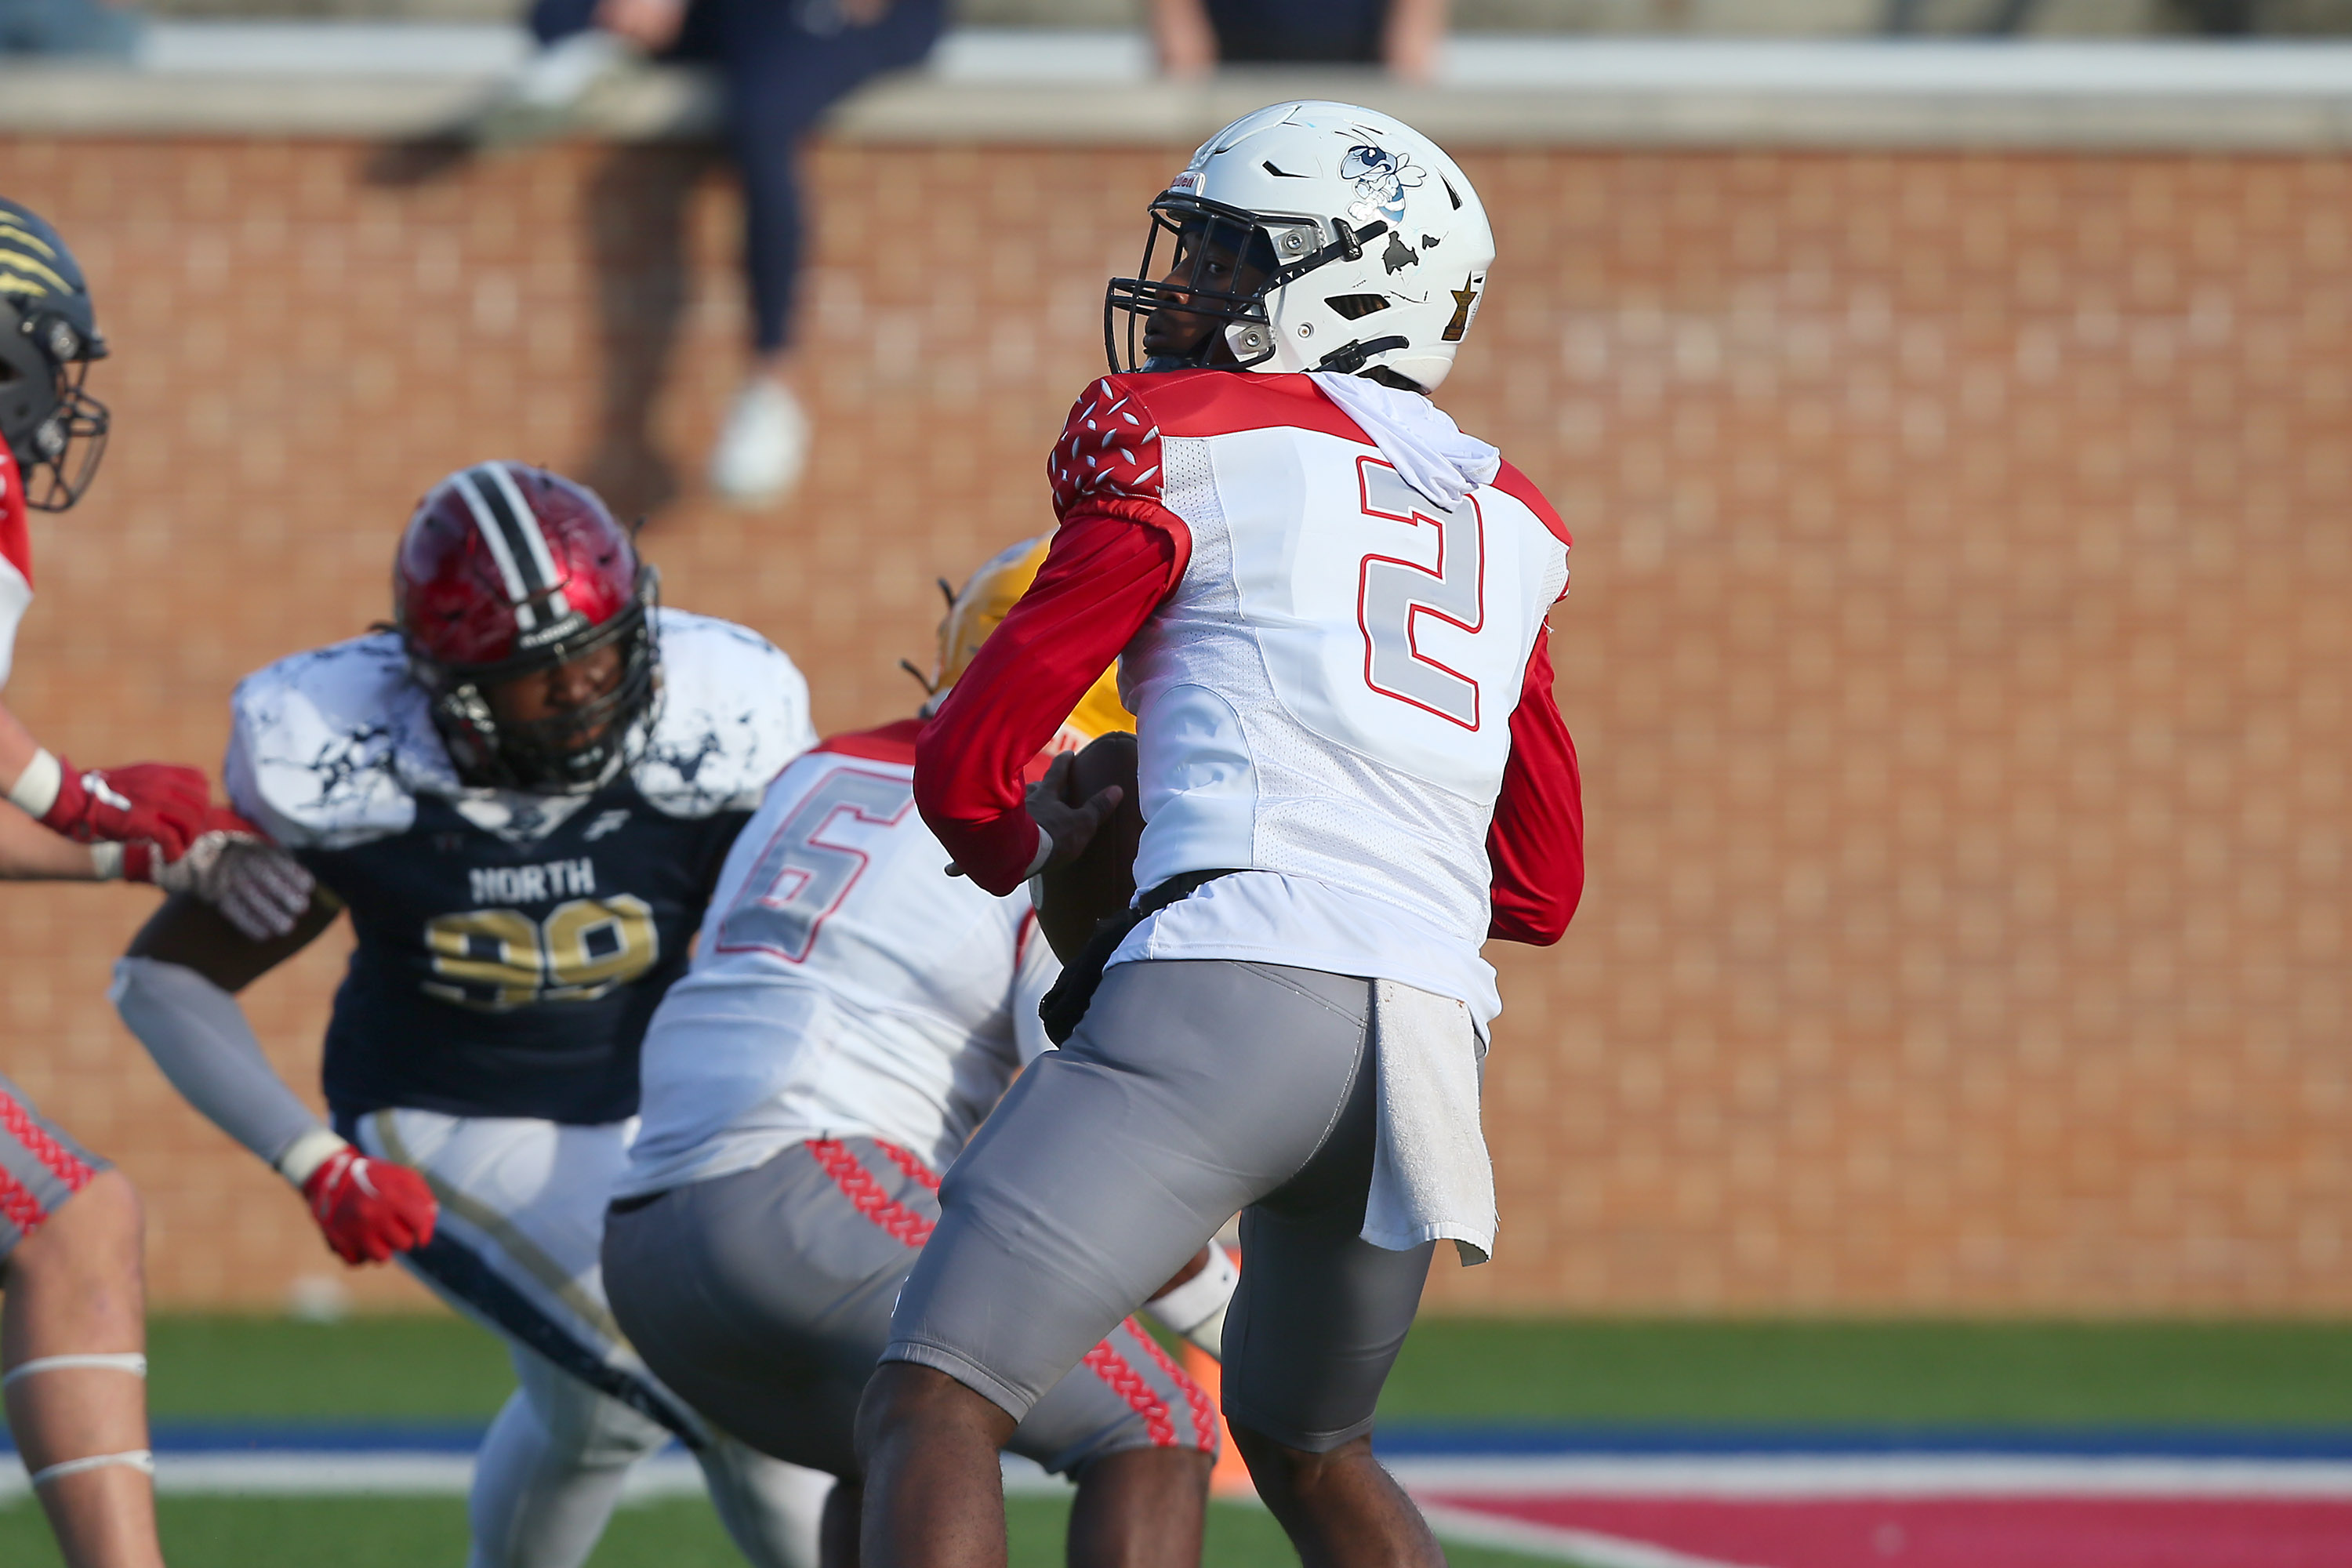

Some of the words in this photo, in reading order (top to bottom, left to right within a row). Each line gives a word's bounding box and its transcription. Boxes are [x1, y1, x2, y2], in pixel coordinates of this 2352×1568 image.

[1356, 455, 1485, 732] 2
[470, 858, 596, 903] NORTH
[716, 767, 916, 965] 6
